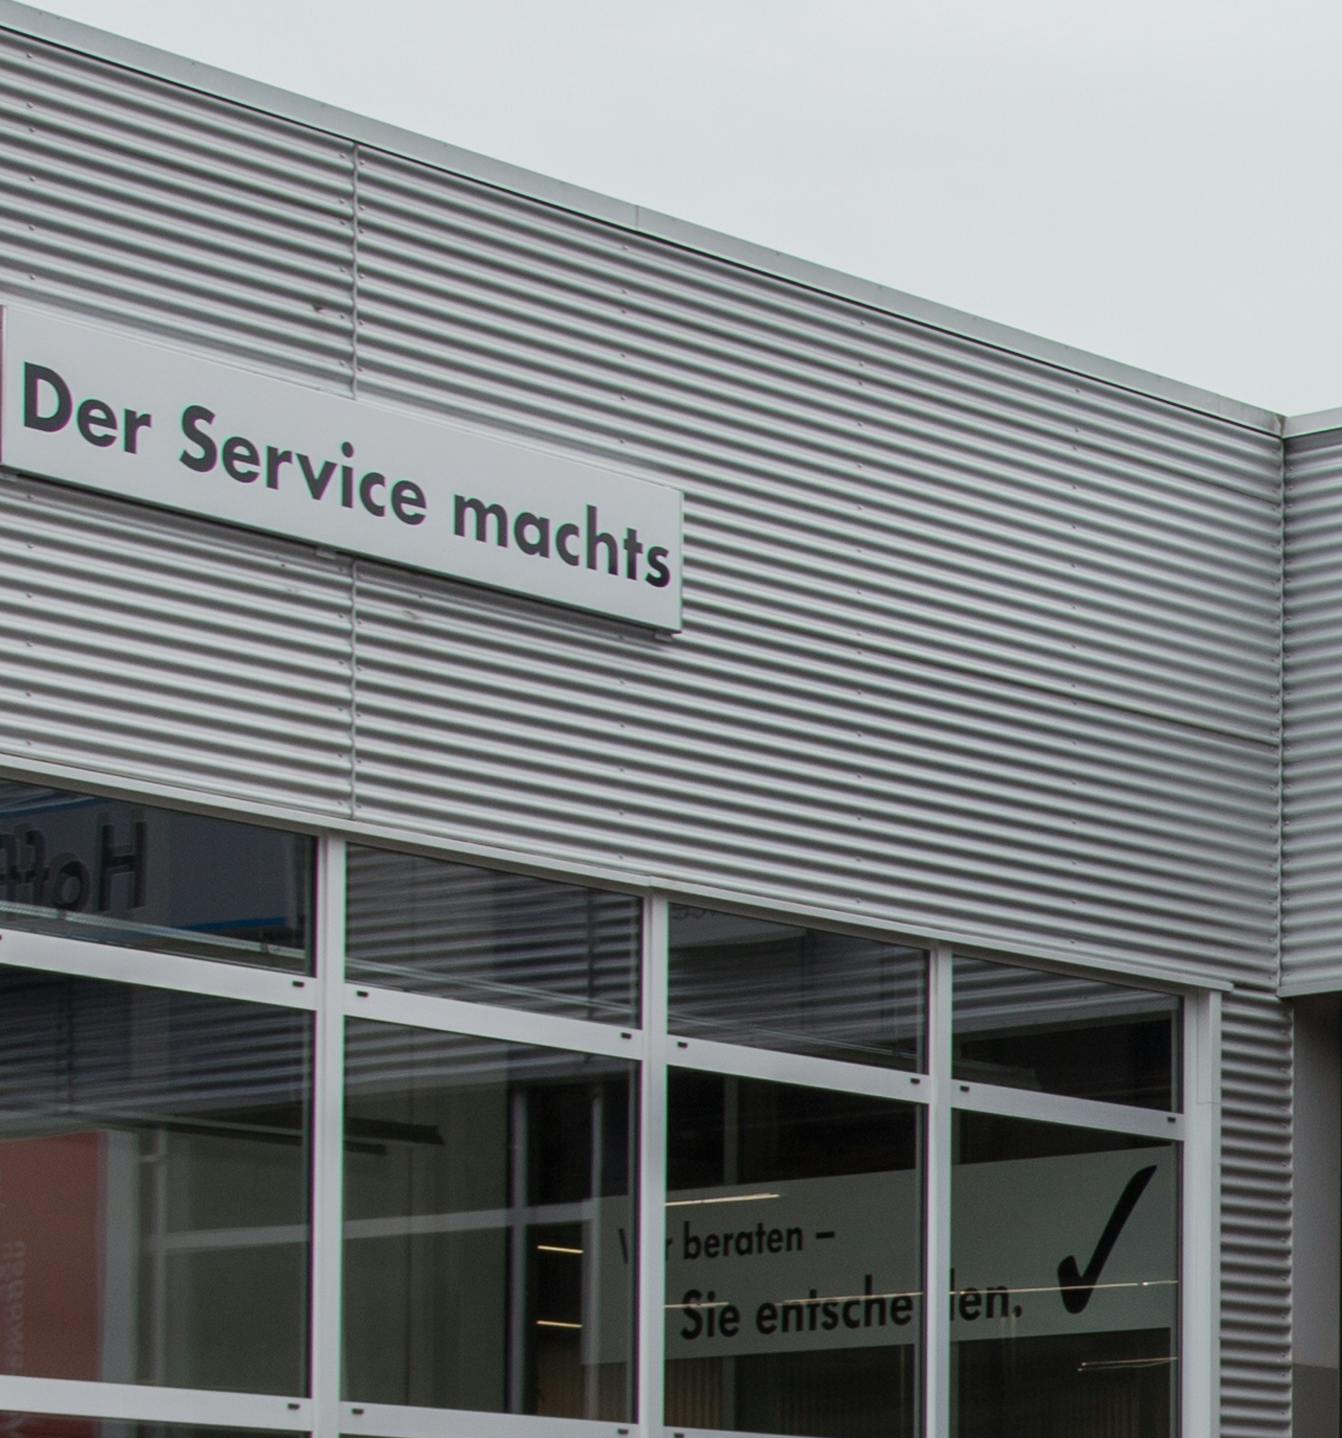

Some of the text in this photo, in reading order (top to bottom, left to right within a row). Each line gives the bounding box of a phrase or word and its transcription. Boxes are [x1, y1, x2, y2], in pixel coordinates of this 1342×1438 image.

[22, 360, 672, 588] Der Service machts
[683, 1220, 804, 1260] beraten
[680, 1268, 1024, 1340] Sie entscheen.
